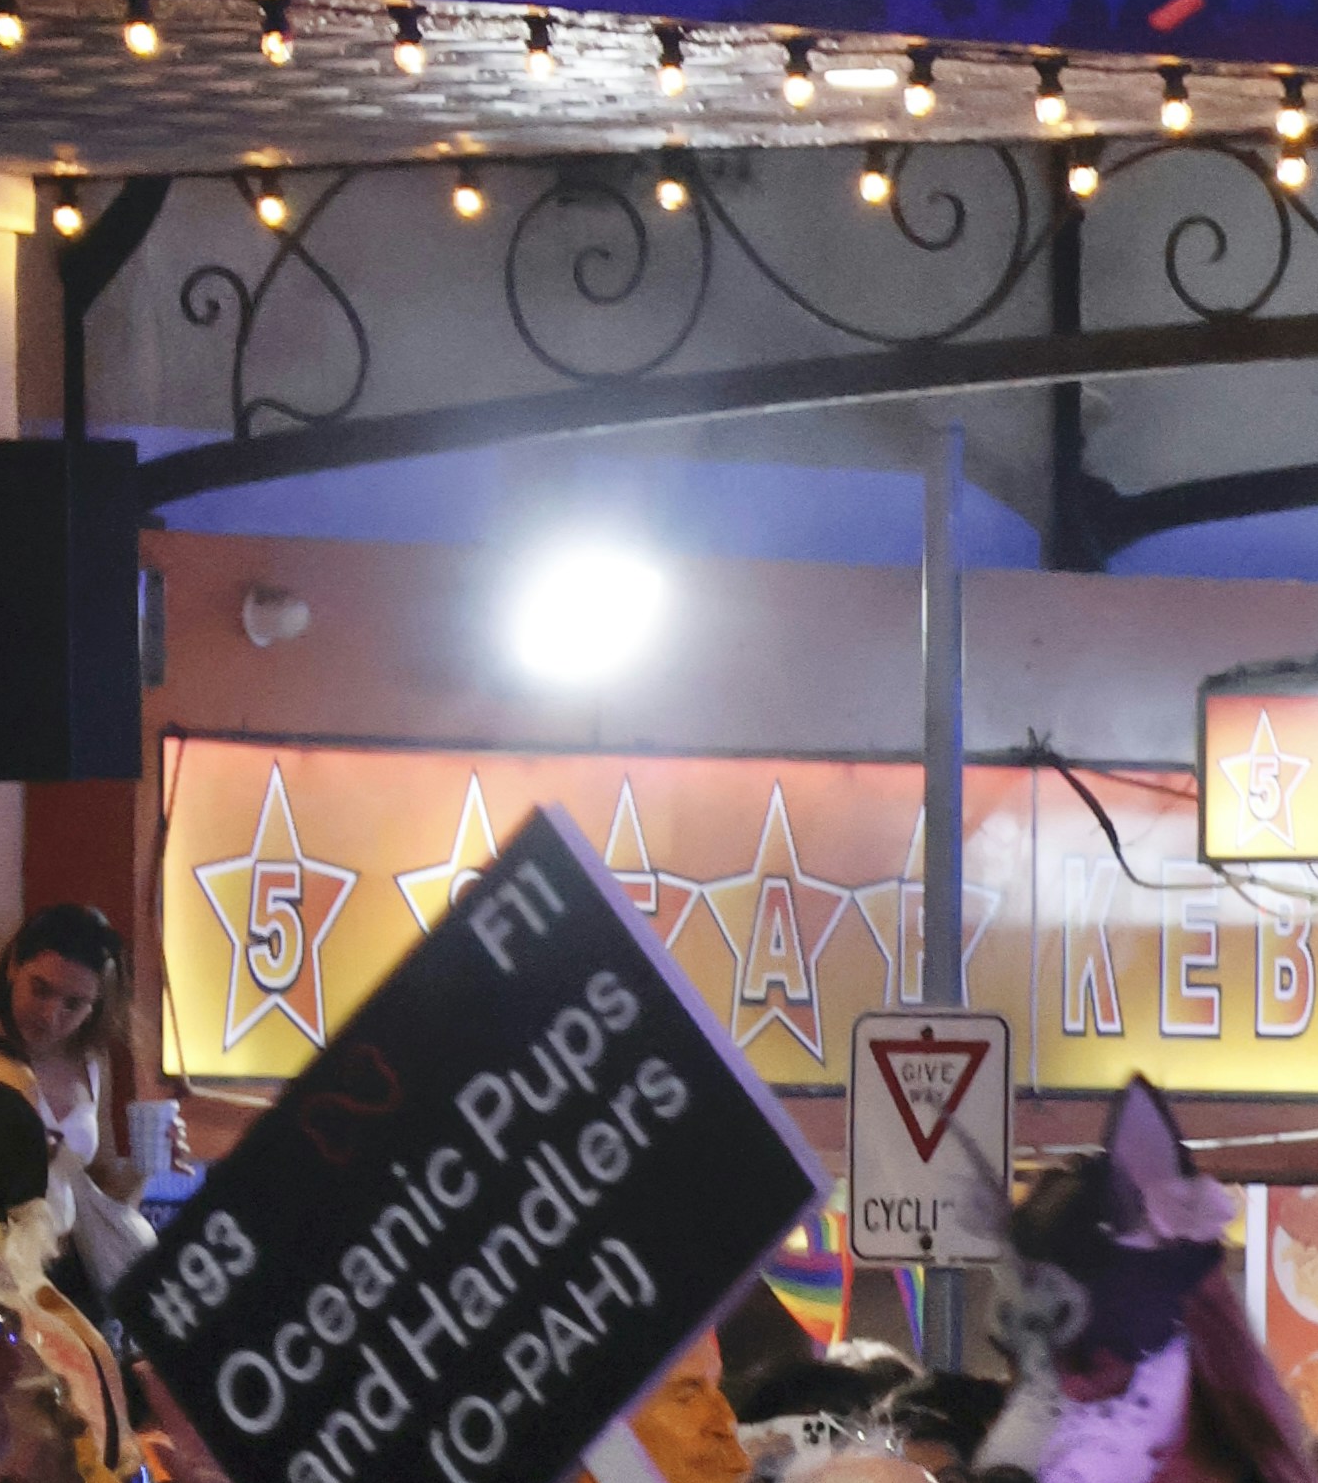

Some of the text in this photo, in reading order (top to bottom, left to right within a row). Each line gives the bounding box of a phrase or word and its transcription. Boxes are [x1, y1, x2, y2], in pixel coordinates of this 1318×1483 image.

[245, 859, 306, 994] 5
[901, 1061, 955, 1083] GIVE
[216, 970, 641, 1435] Oceanic Pups
[387, 1055, 690, 1381] Handlers
[863, 1197, 955, 1233] CYCLI
[149, 1210, 257, 1340] #93
